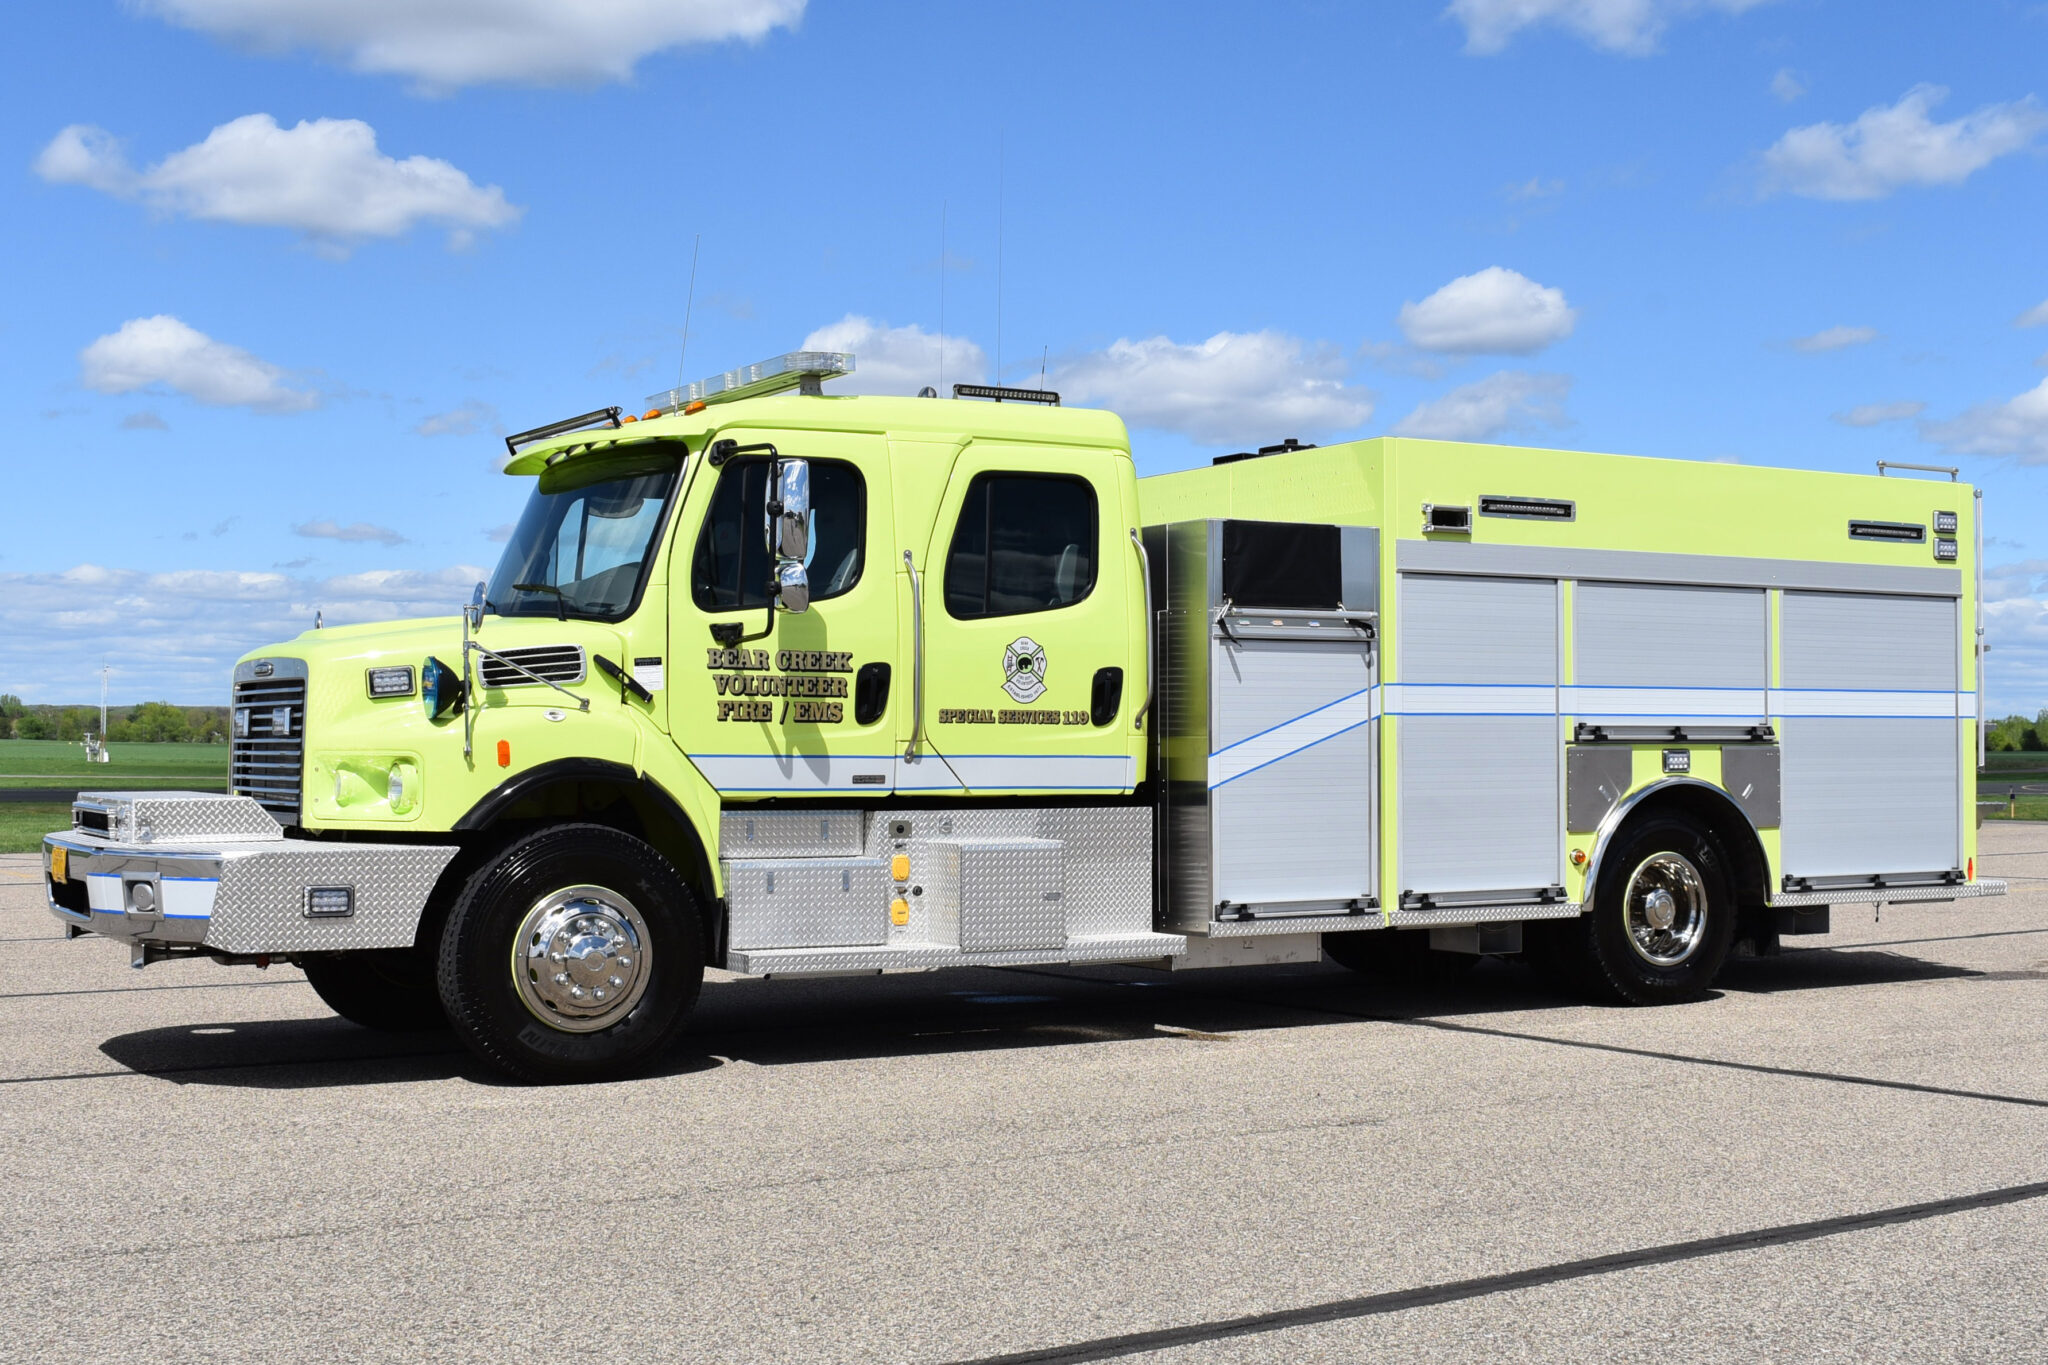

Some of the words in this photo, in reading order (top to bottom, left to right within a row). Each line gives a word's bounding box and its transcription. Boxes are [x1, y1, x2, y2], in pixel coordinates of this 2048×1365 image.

[707, 648, 770, 671] BEAR
[775, 650, 853, 673] CREEK
[713, 674, 848, 698] VOLUNTEER
[717, 700, 773, 722] FIRE
[780, 701, 789, 725] /
[793, 702, 843, 723] EMS
[939, 709, 995, 724] SPECIAL
[998, 710, 1060, 725] SERVICES
[1063, 711, 1089, 725] 119
